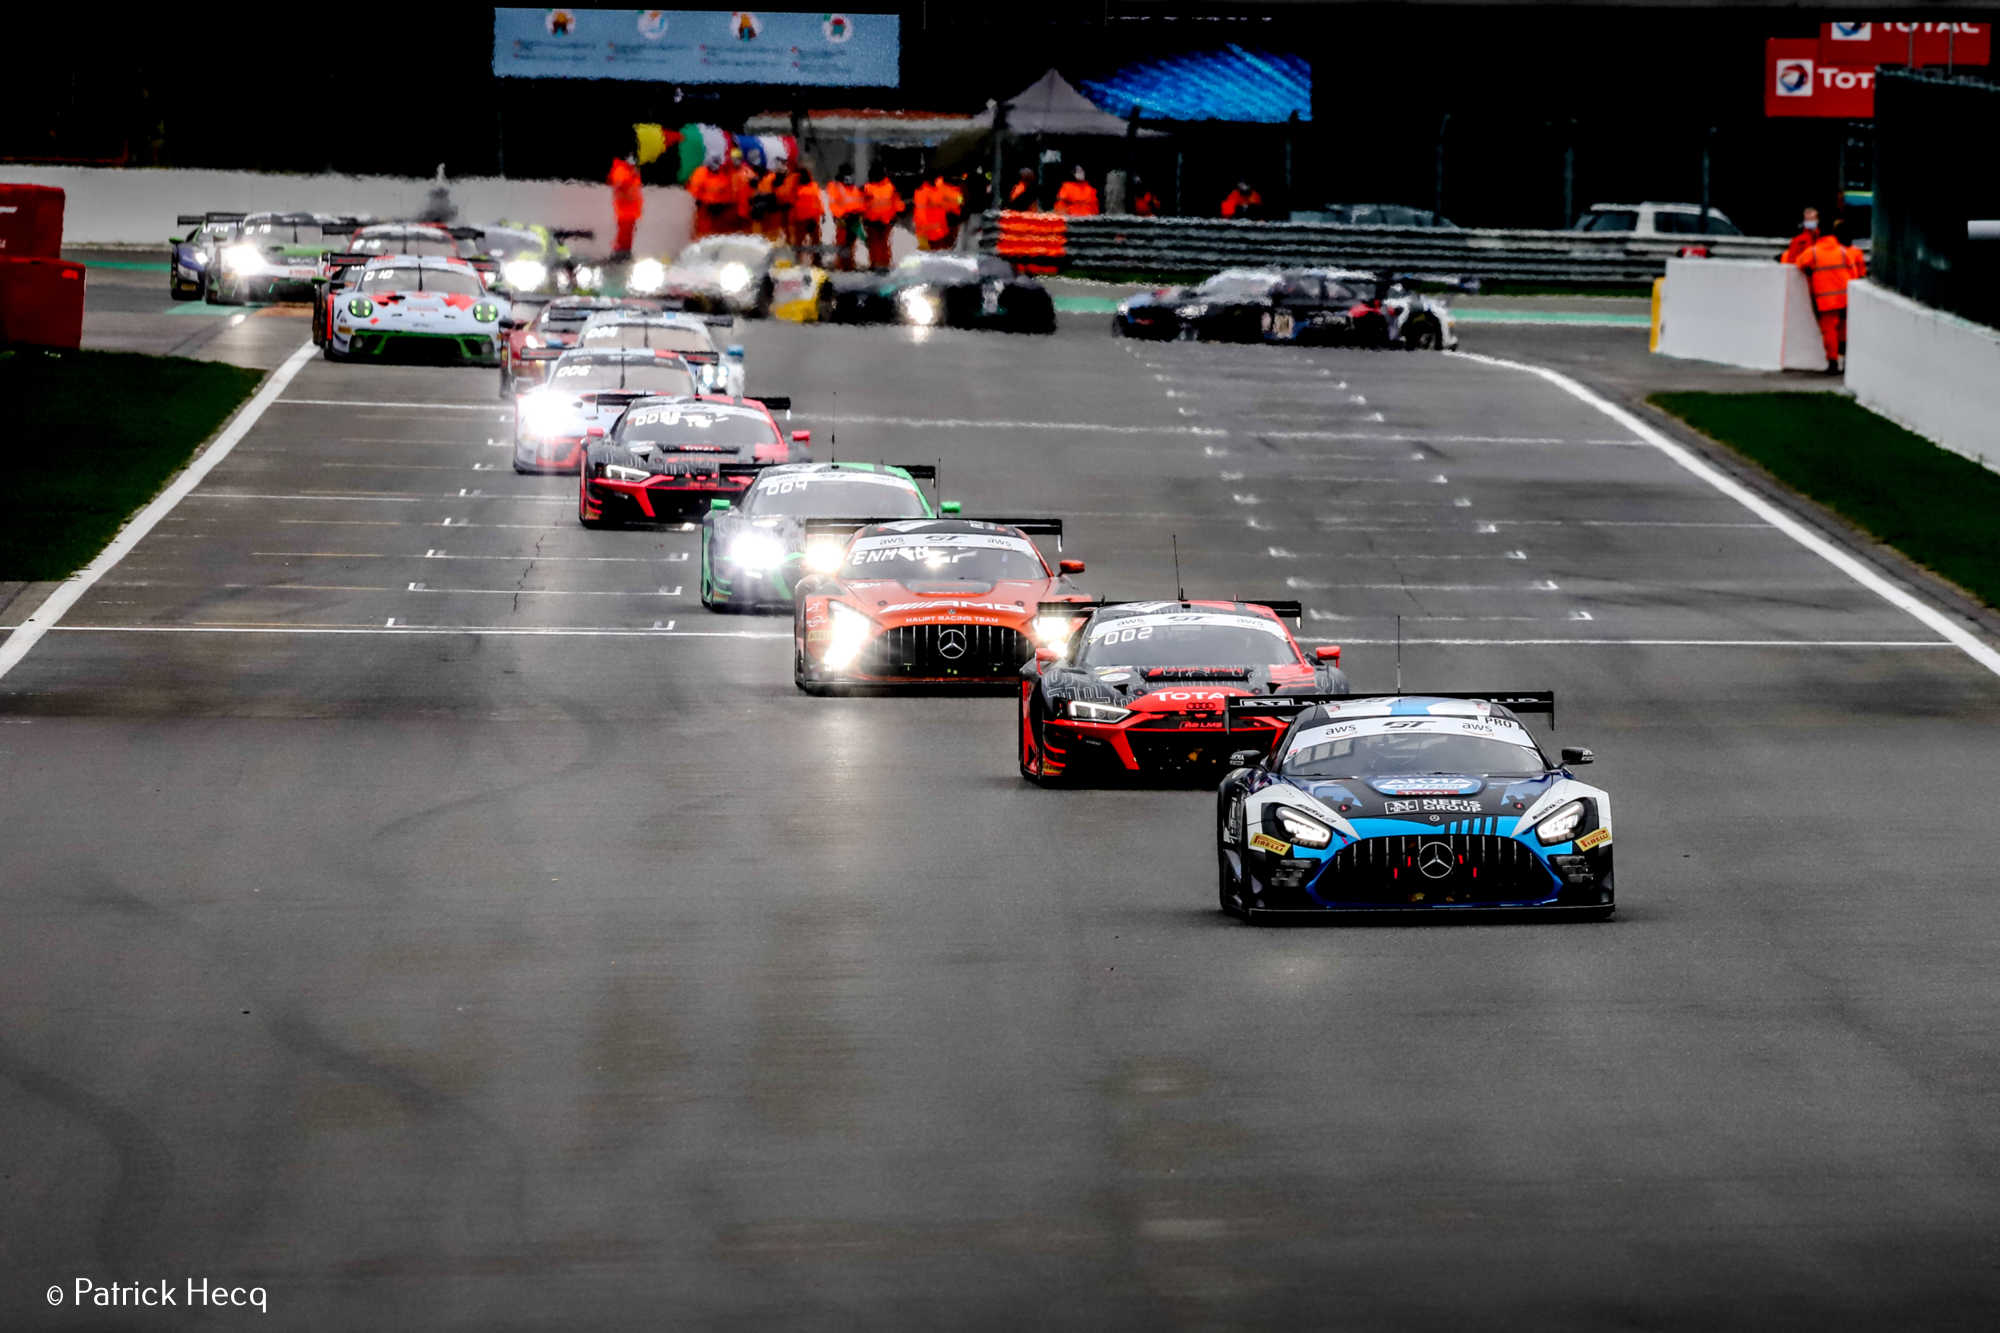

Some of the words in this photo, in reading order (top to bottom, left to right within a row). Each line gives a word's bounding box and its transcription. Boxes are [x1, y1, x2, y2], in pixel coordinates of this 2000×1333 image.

[1817, 68, 1875, 89] TOT
[1104, 626, 1153, 646] 002
[1151, 691, 1237, 702] TOTA
[1325, 724, 1358, 737] aws
[1461, 721, 1494, 734] aws
[1484, 717, 1513, 729] PRO
